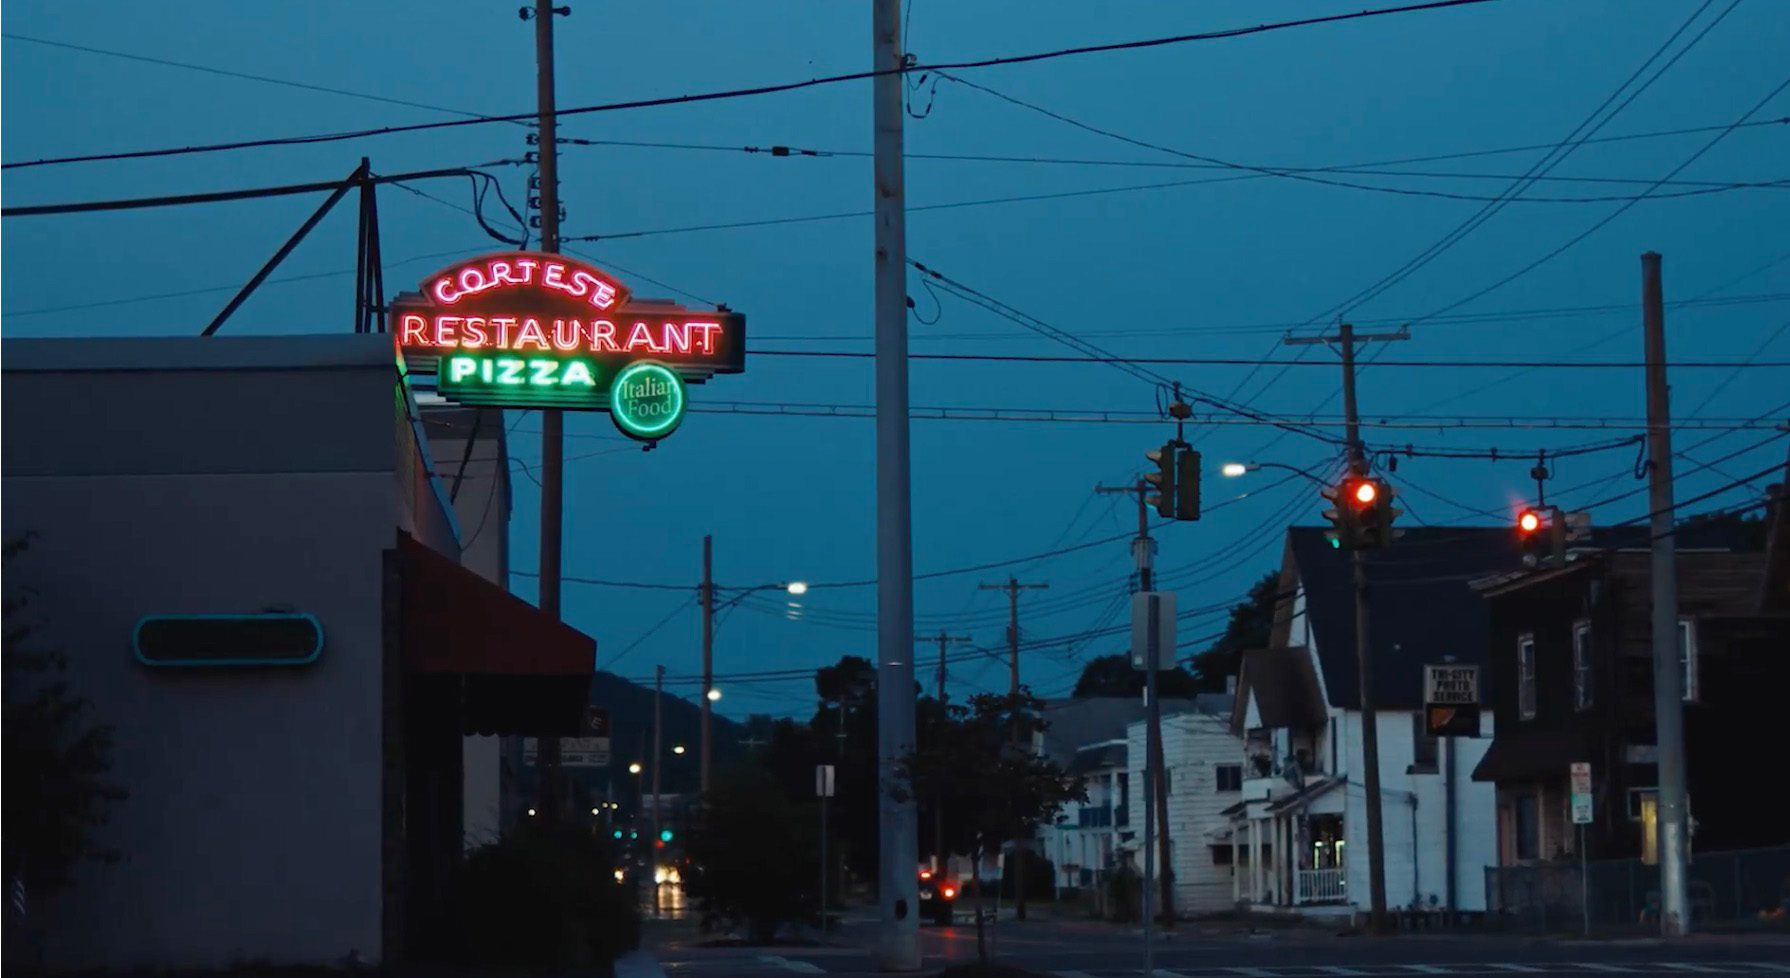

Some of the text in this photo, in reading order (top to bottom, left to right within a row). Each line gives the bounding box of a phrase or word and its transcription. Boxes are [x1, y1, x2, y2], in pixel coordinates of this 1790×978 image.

[435, 260, 616, 309] CORTESE
[400, 315, 723, 356] RESTAURANT
[450, 357, 596, 386] PIZZA
[628, 394, 672, 418] Food
[1433, 691, 1472, 702] SERVICE
[1437, 681, 1470, 690] PHOTO
